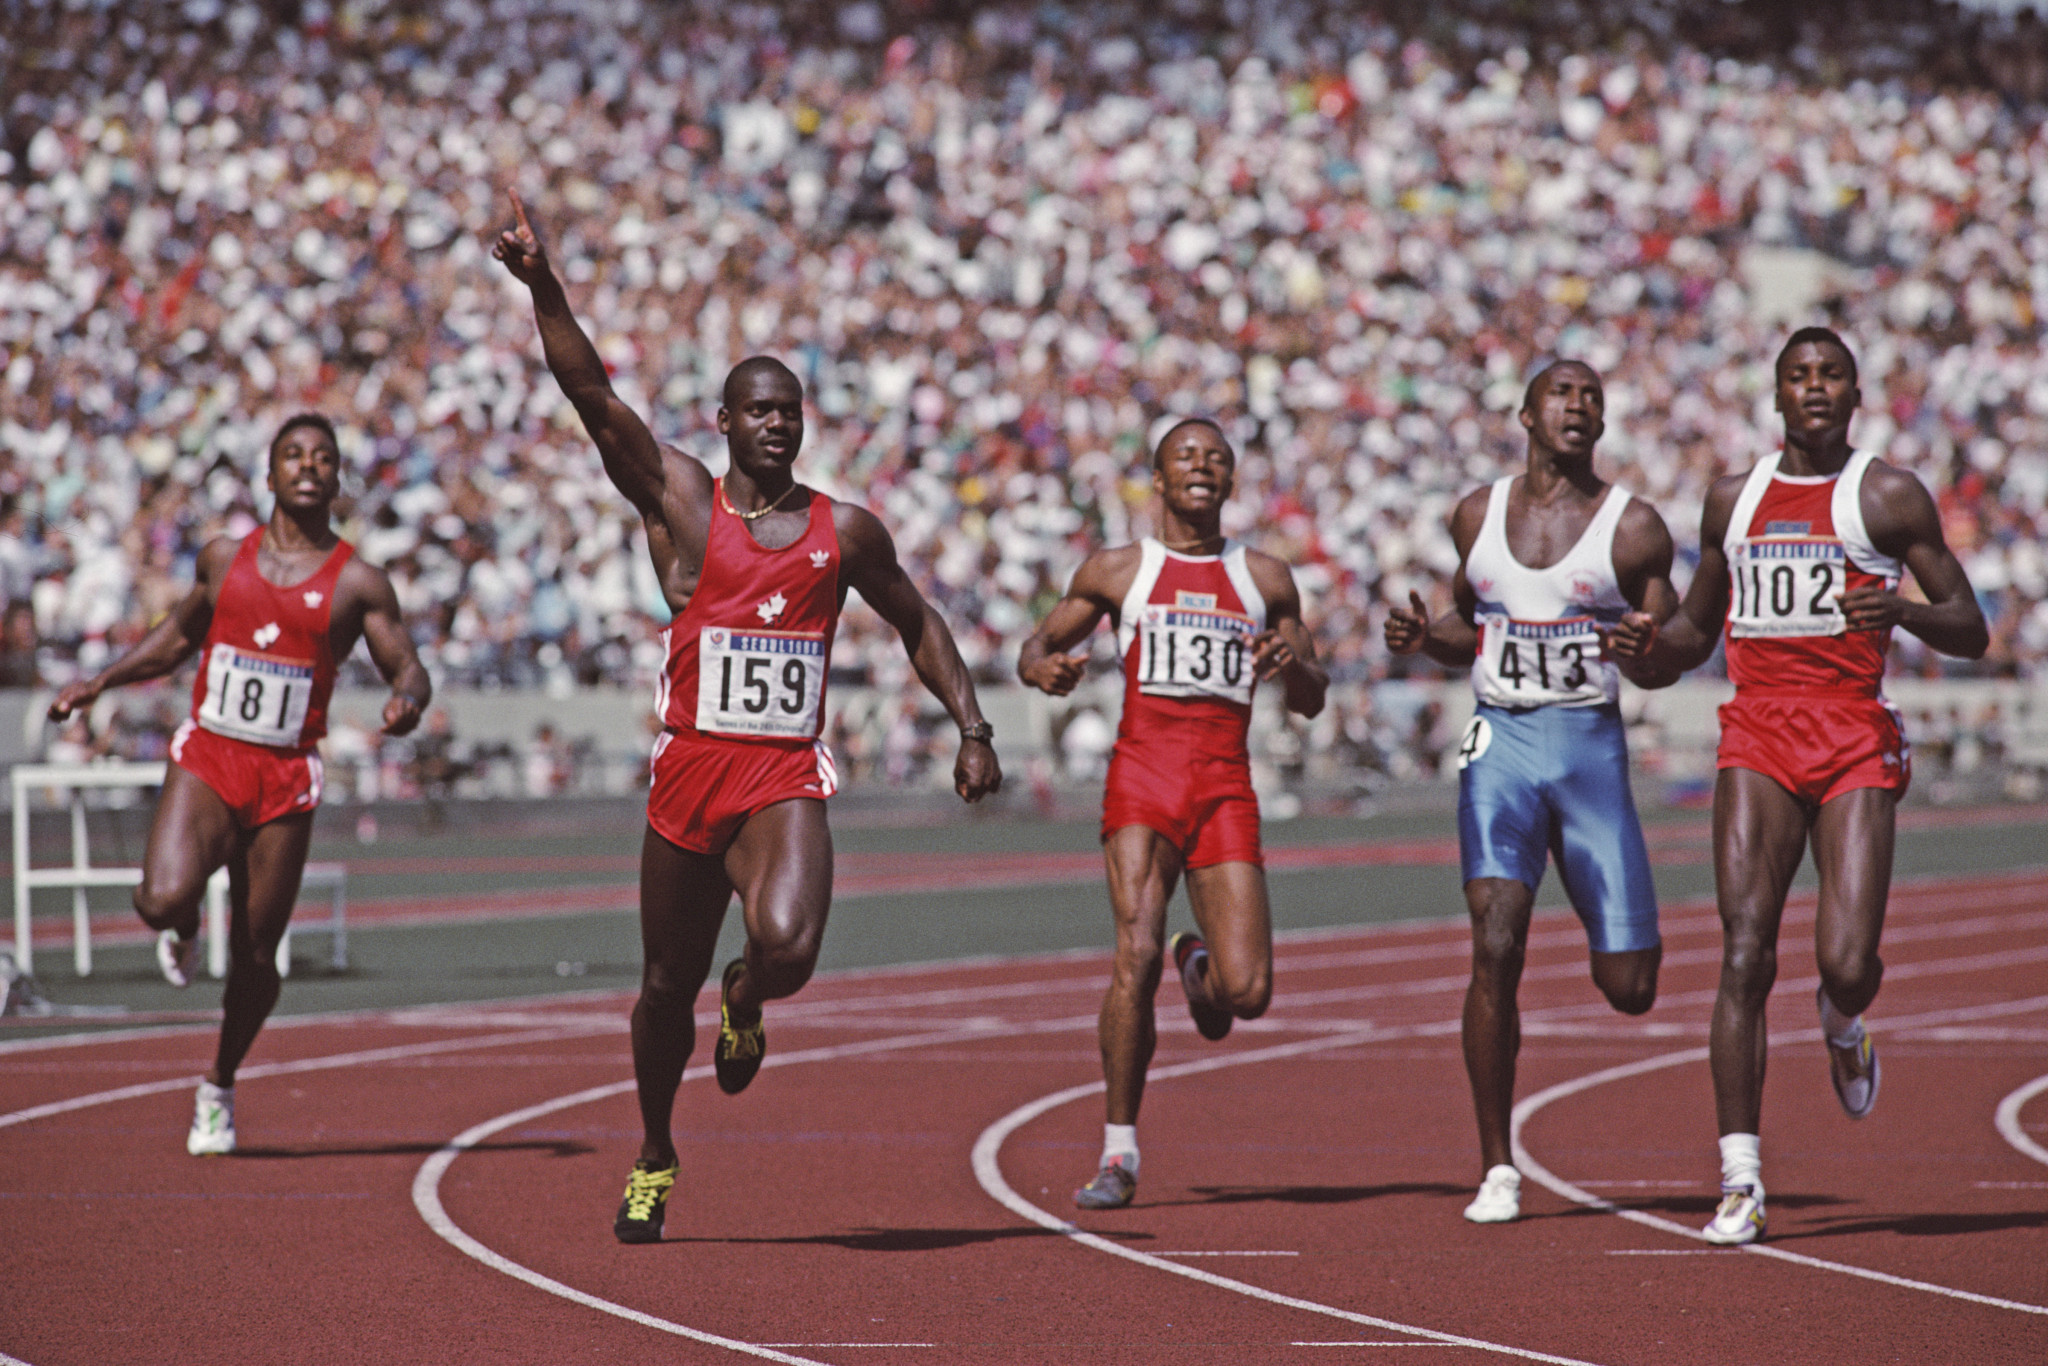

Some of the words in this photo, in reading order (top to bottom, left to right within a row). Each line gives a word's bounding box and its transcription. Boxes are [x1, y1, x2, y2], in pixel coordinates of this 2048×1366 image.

[1737, 563, 1834, 618] 1102
[741, 636, 785, 653] SEOUL
[1147, 631, 1245, 686] 1130
[1499, 642, 1587, 689] 413
[219, 670, 292, 730] 181
[719, 655, 806, 715] 159
[1459, 720, 1482, 762] 4
